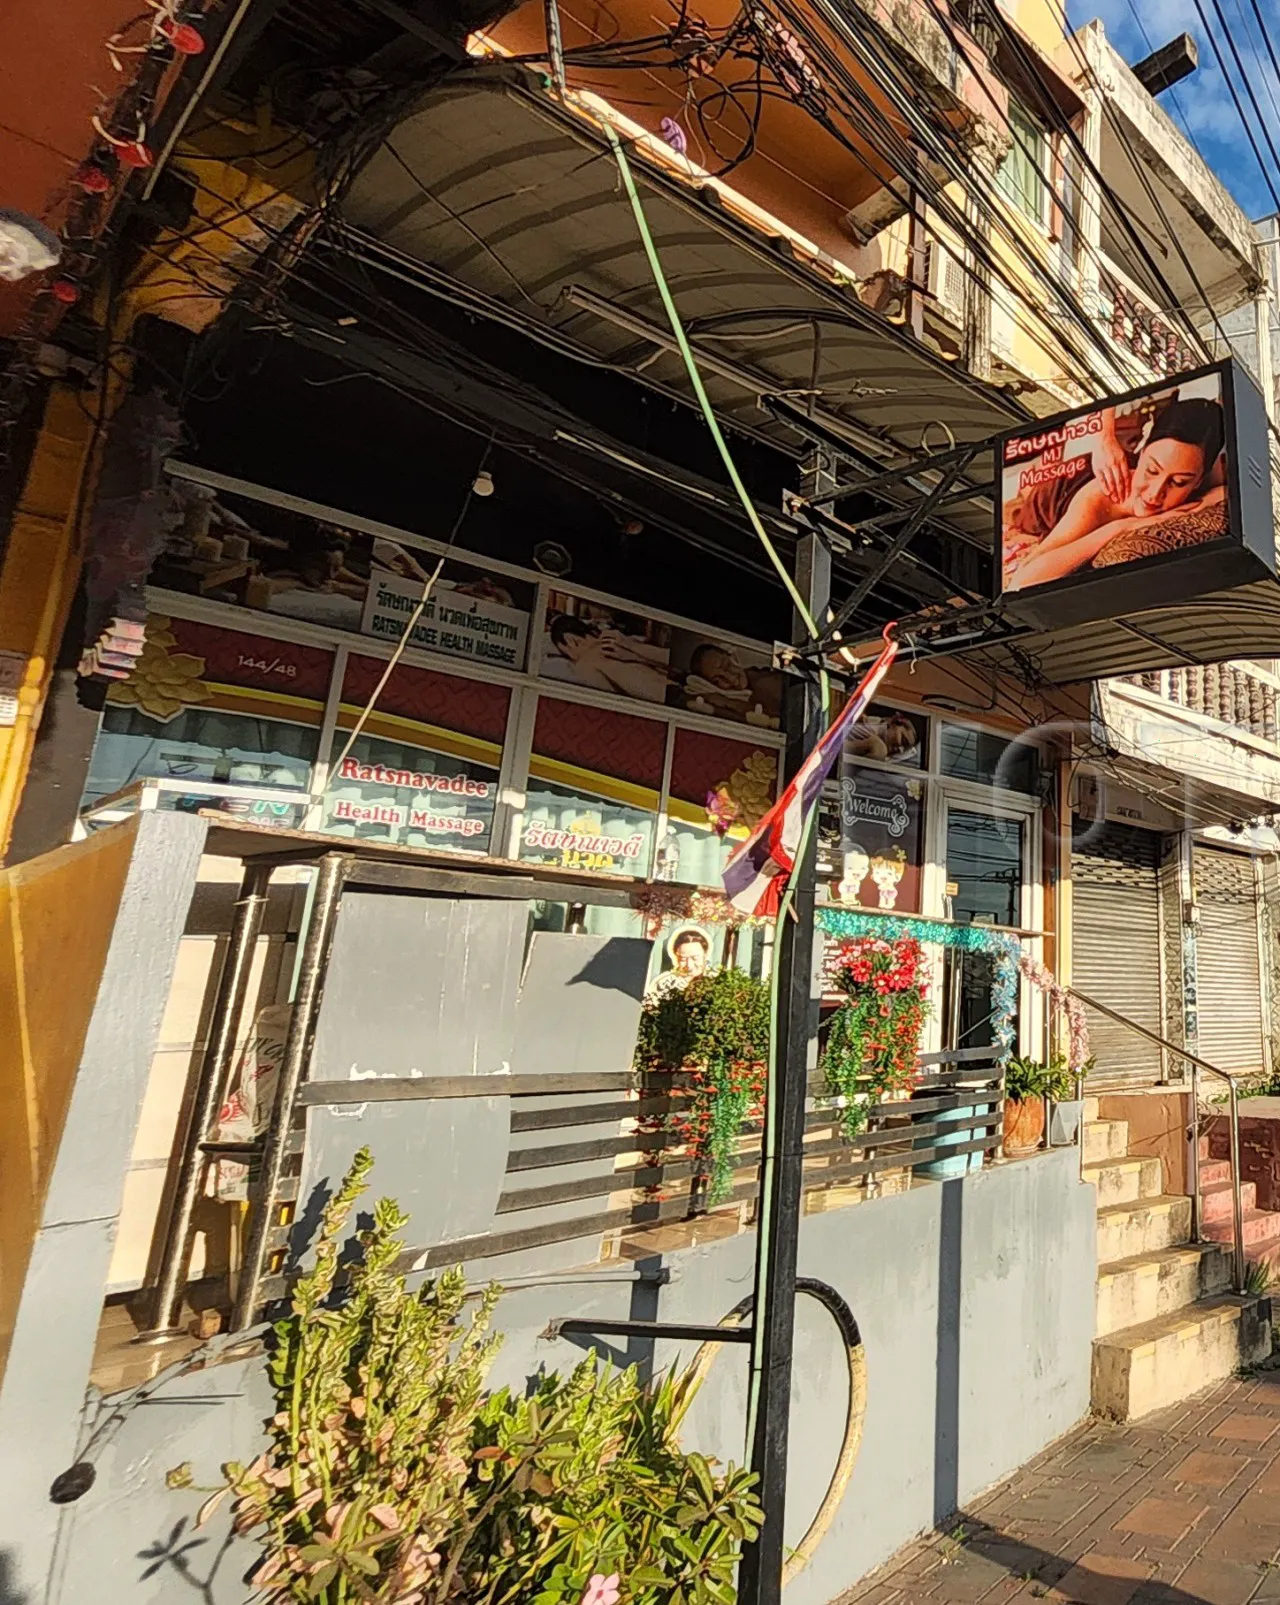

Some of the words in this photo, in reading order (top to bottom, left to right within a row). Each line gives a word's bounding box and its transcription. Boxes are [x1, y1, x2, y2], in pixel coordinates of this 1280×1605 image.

[1043, 446, 1062, 463] MJ
[1020, 458, 1086, 487] Massage
[372, 615, 438, 645] RATSNVADEE
[440, 631, 474, 653] HEALTH
[476, 640, 517, 664] MASSAGE
[238, 655, 297, 677] 144/48
[339, 757, 488, 796] Ratsnavadee
[336, 801, 400, 823] Health
[410, 810, 484, 835] Massage
[849, 797, 898, 819] Welcome
